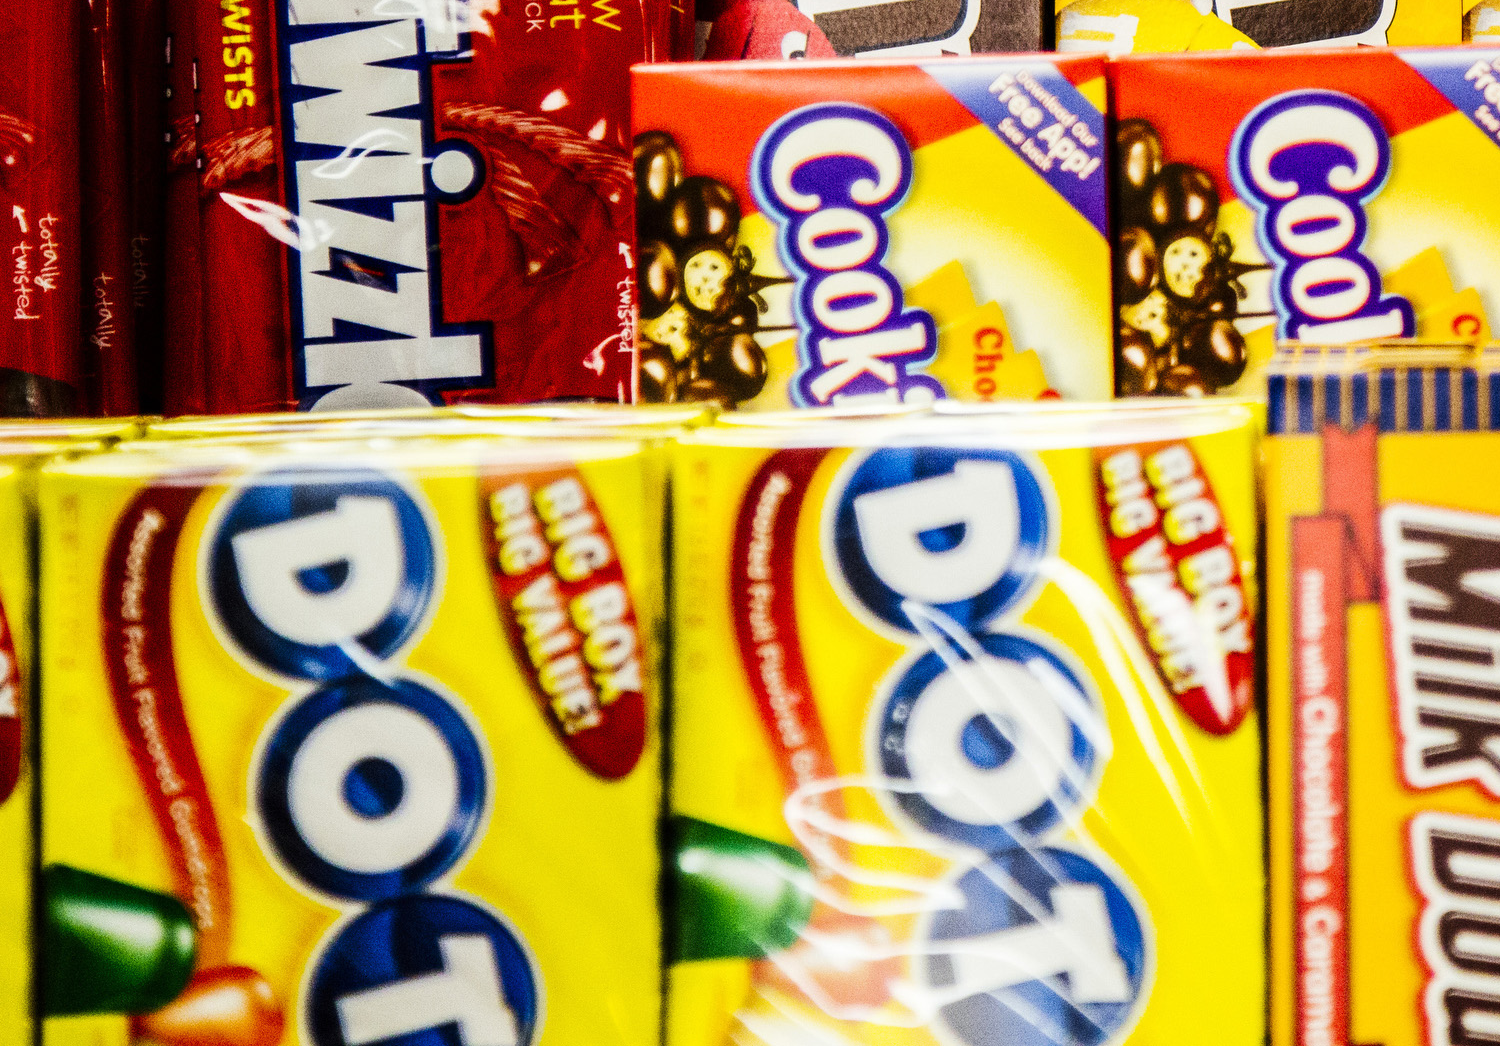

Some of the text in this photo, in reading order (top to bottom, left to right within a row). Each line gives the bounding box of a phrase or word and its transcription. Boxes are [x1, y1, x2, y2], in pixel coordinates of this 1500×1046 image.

[988, 71, 1101, 180] Free App!
[14, 241, 40, 321] twisted
[36, 213, 59, 291] totally
[1101, 449, 1160, 539] BIG
[536, 478, 642, 704] BIG BOX
[1145, 444, 1252, 654] BIG BOX
[490, 483, 601, 735] BIG VALUE!
